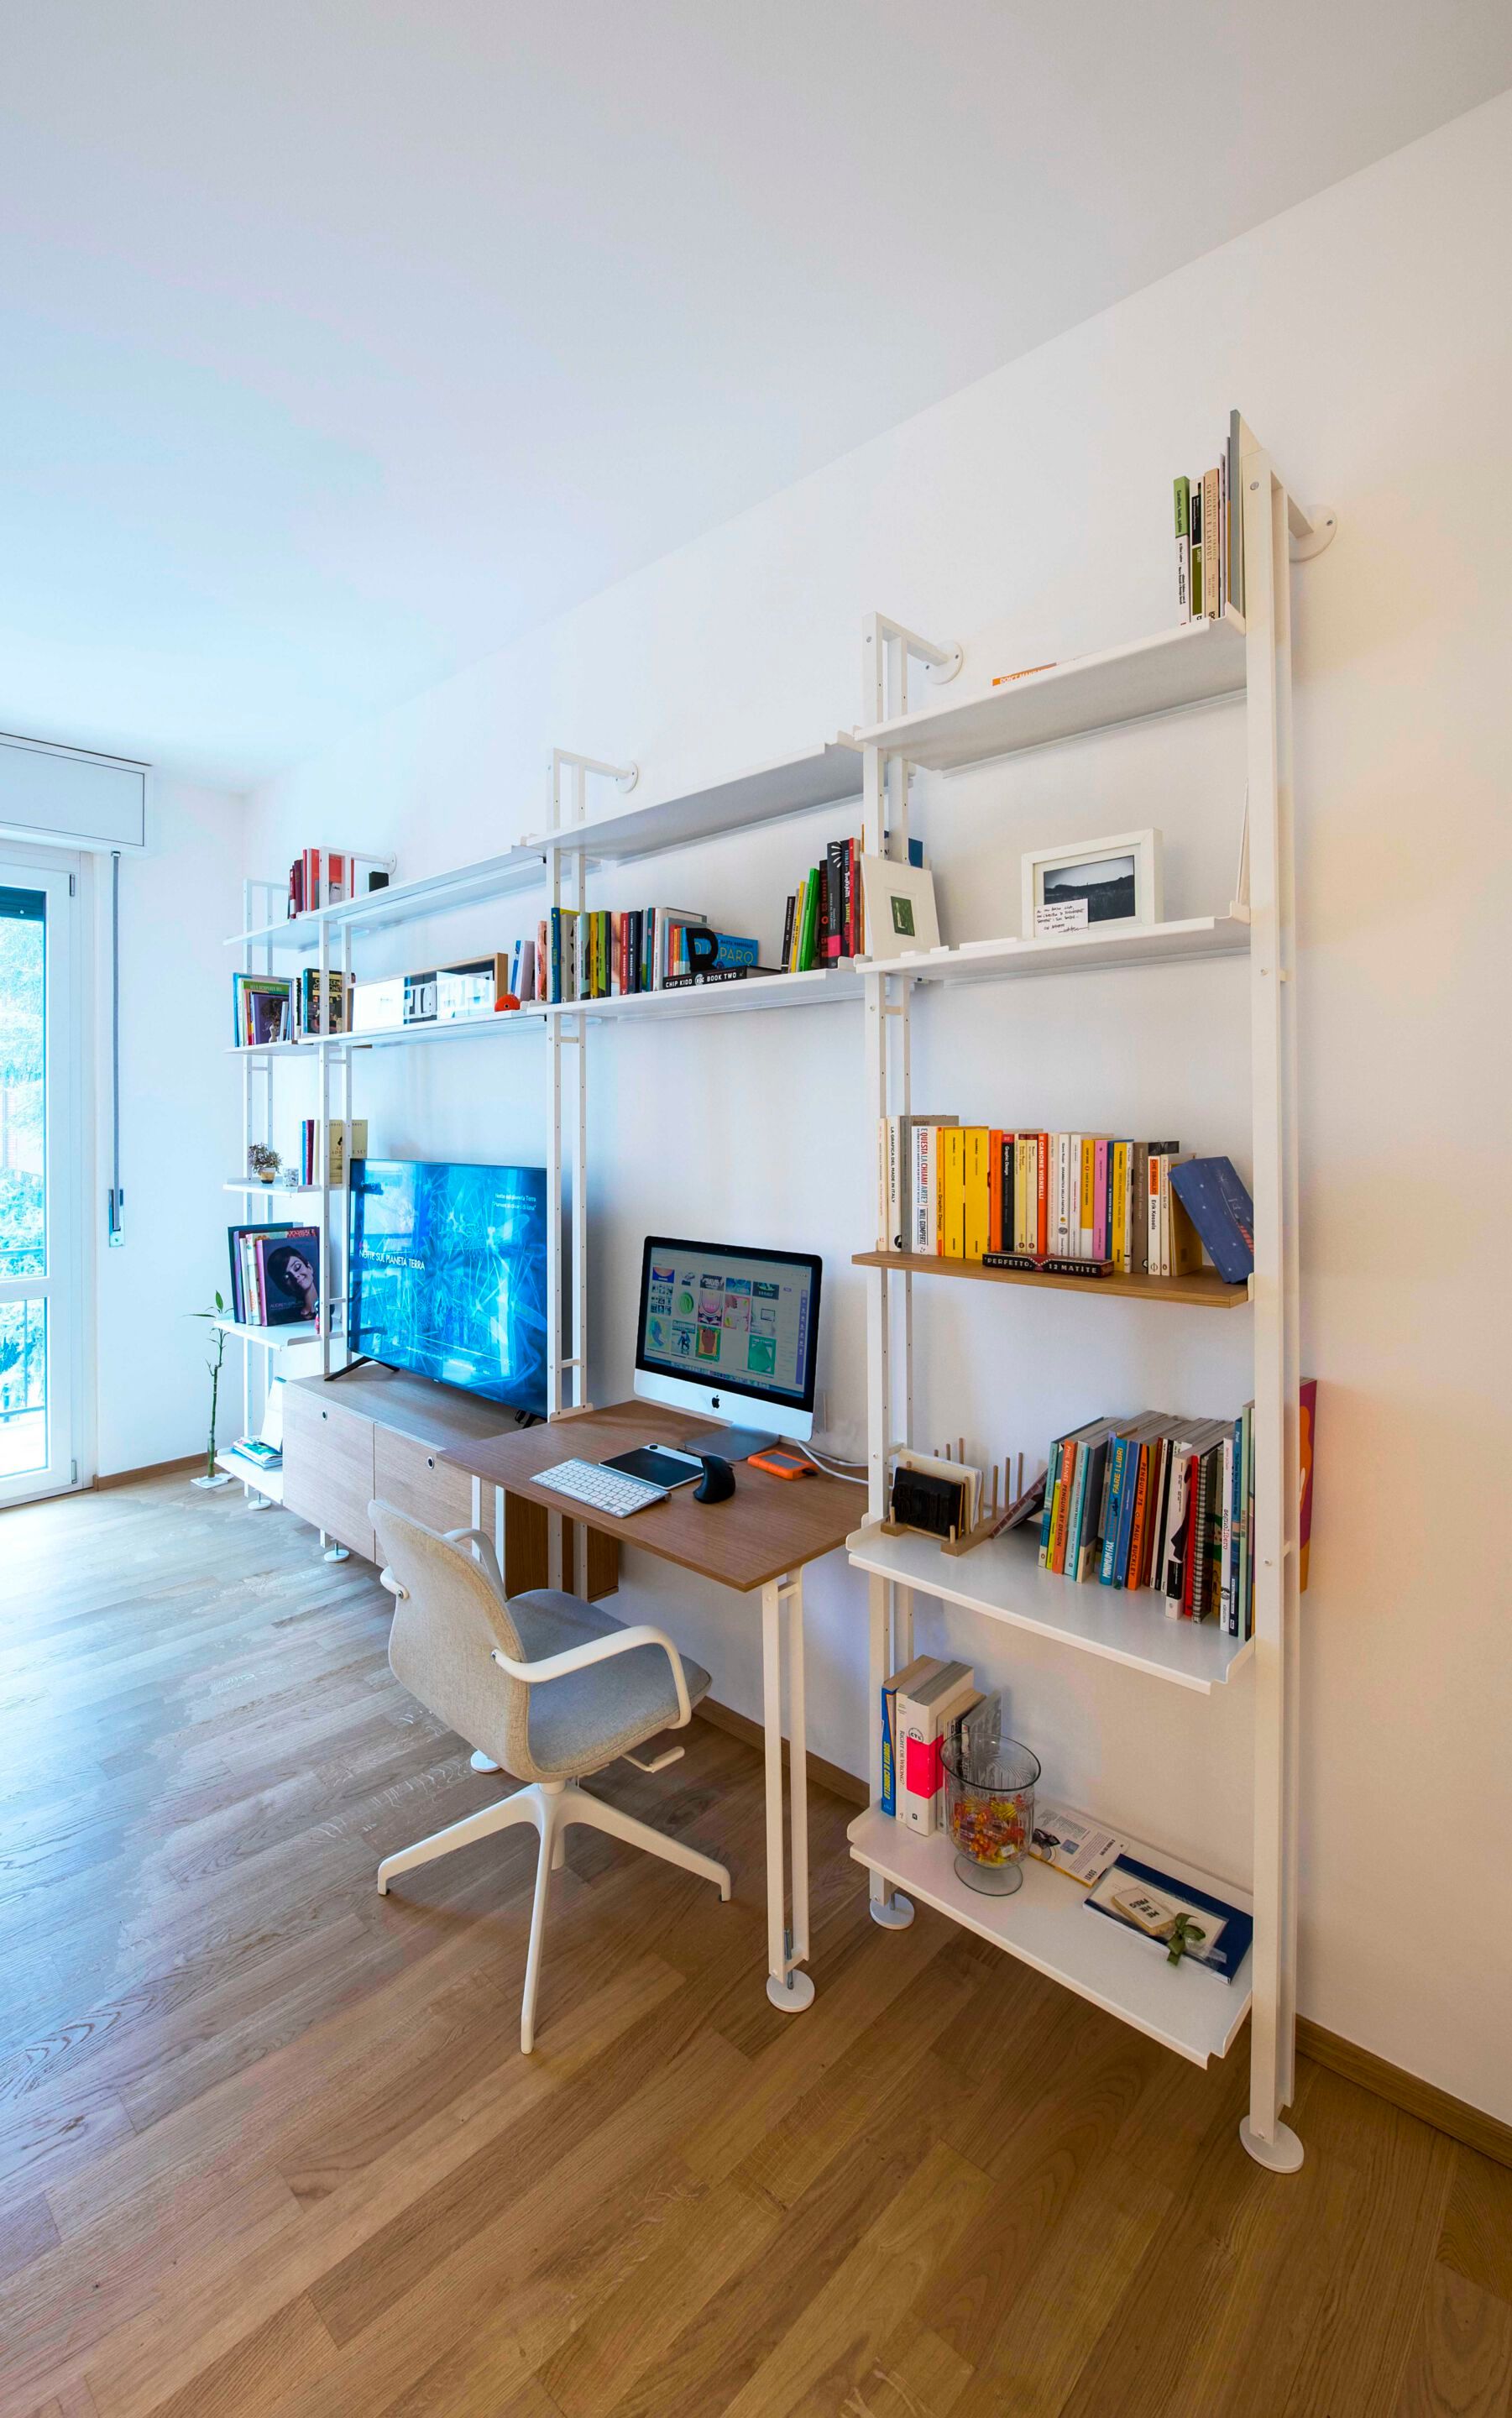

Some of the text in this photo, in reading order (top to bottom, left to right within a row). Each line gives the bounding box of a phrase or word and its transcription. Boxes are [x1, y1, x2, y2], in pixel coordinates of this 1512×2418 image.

[359, 1249, 425, 1271] NOTTE SUL PIANETA TERRA
[1061, 1264, 1097, 1274] MATITE
[1138, 1462, 1146, 1494] PENGUIN
[1059, 1514, 1064, 1524] BY
[1102, 1541, 1115, 1578] MINIMUM FAX
